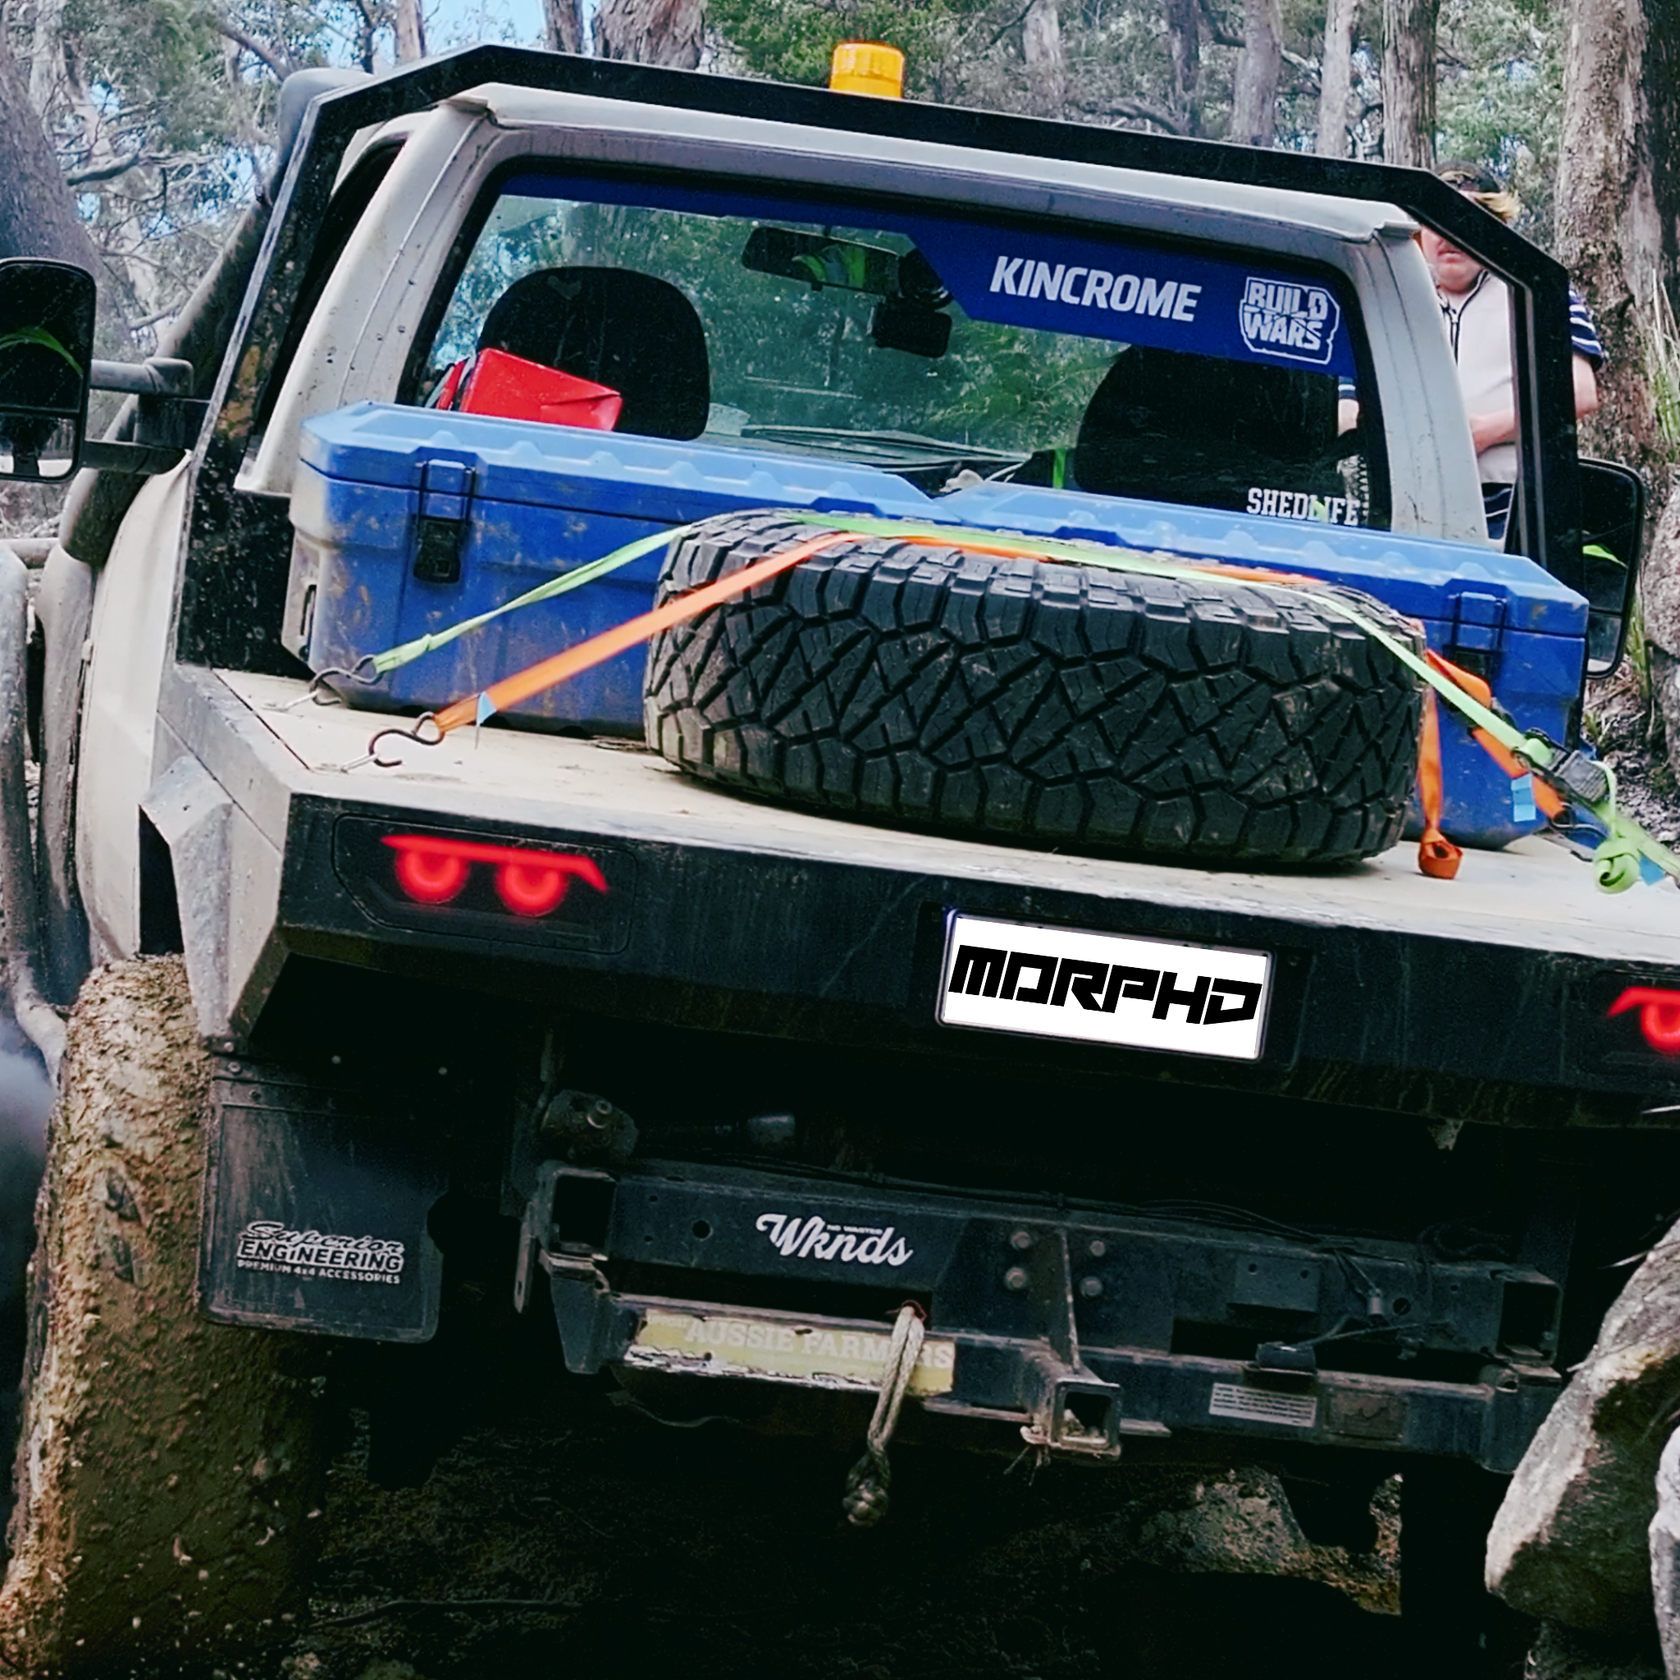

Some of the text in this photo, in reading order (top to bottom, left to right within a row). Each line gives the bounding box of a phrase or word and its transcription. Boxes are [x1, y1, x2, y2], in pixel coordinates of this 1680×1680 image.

[989, 255, 1203, 323] KINCROME
[1247, 281, 1329, 322] BUILD
[1243, 304, 1322, 351] WARS
[948, 944, 1263, 1025] MORPHD
[236, 1238, 404, 1273] ENGINEERING
[755, 1213, 914, 1266] Wknds
[237, 1259, 292, 1274] PREMIUM
[318, 1267, 401, 1284] ACCESSORIES
[685, 1320, 794, 1352] AUSSIE
